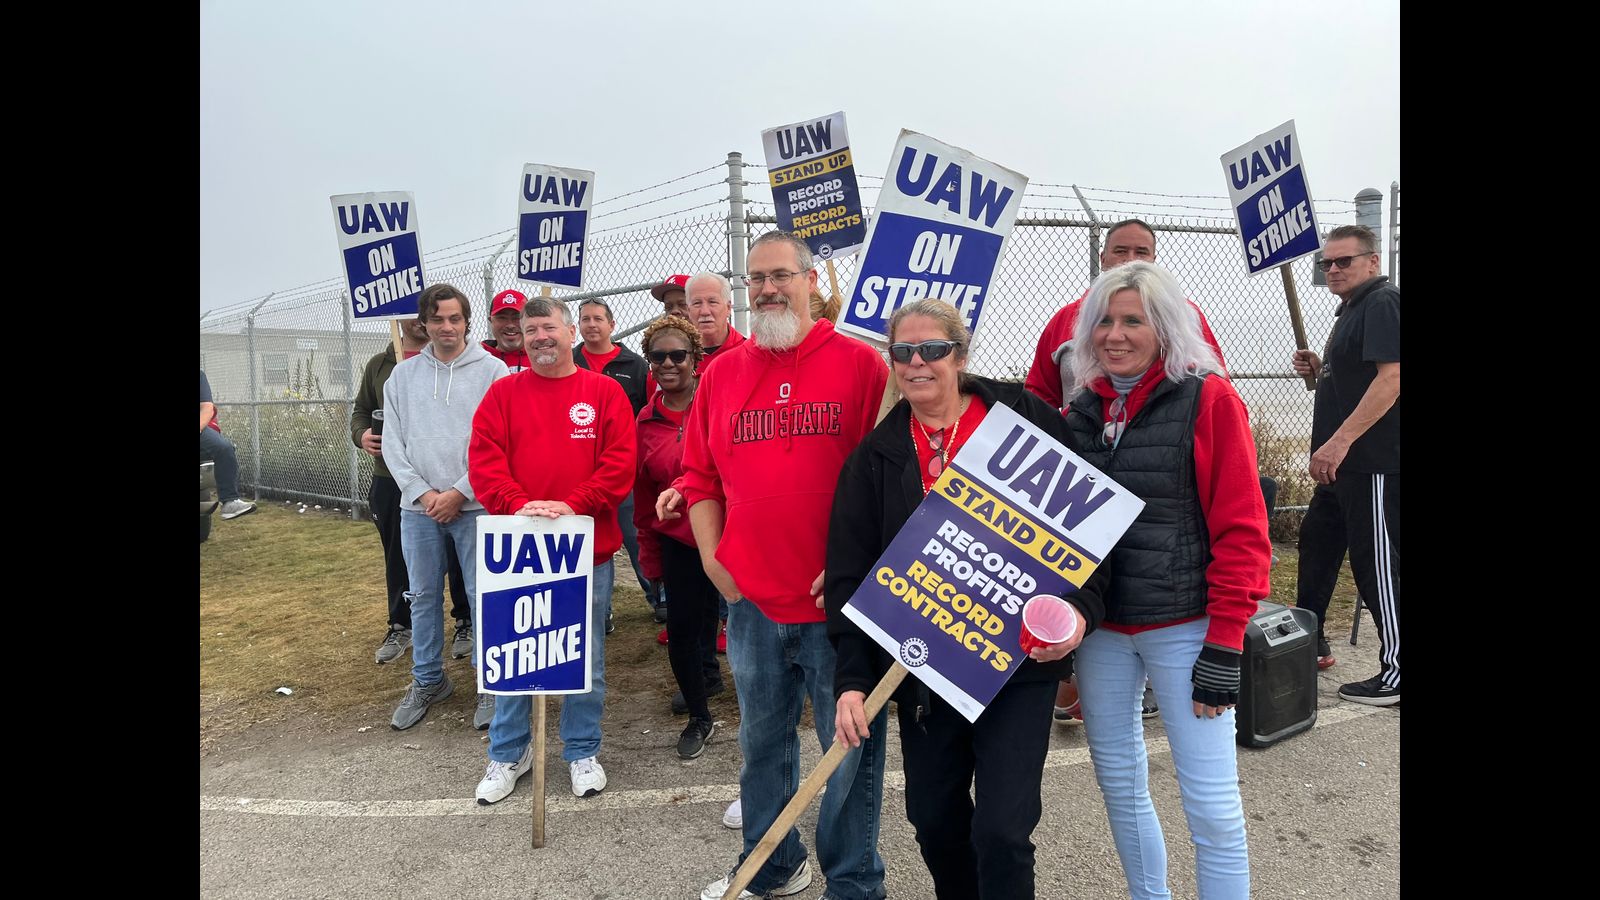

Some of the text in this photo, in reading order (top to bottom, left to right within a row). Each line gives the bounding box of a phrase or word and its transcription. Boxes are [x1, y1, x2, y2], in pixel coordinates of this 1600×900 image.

[776, 118, 831, 160] UAW
[774, 154, 847, 184] STAND UP
[1229, 134, 1292, 191] UAW
[523, 173, 588, 208] UAW
[787, 178, 843, 202] RECORD
[790, 190, 845, 214] PROFITS
[895, 146, 1014, 229] UAW
[1257, 184, 1285, 225] ON
[337, 201, 409, 235] UAW
[538, 216, 564, 244] ON
[792, 205, 847, 229] RECORD
[792, 213, 861, 239] ONTRACTS
[1247, 200, 1312, 267] STRIKE
[367, 242, 396, 276] ON
[520, 241, 581, 275] STRIKE
[908, 230, 963, 276] ON
[354, 265, 421, 313] STRIKE
[731, 401, 842, 444] OHIO STATE
[986, 423, 1116, 532] UAW
[944, 477, 1083, 574] STAND UP
[484, 532, 586, 574] UAW
[936, 519, 1037, 594] RECORD
[906, 559, 1005, 636] RECORD
[921, 537, 1024, 615] PROFITS
[513, 589, 552, 634] ON
[875, 566, 1013, 673] CONTRACTS
[485, 622, 581, 684] STRIKE
